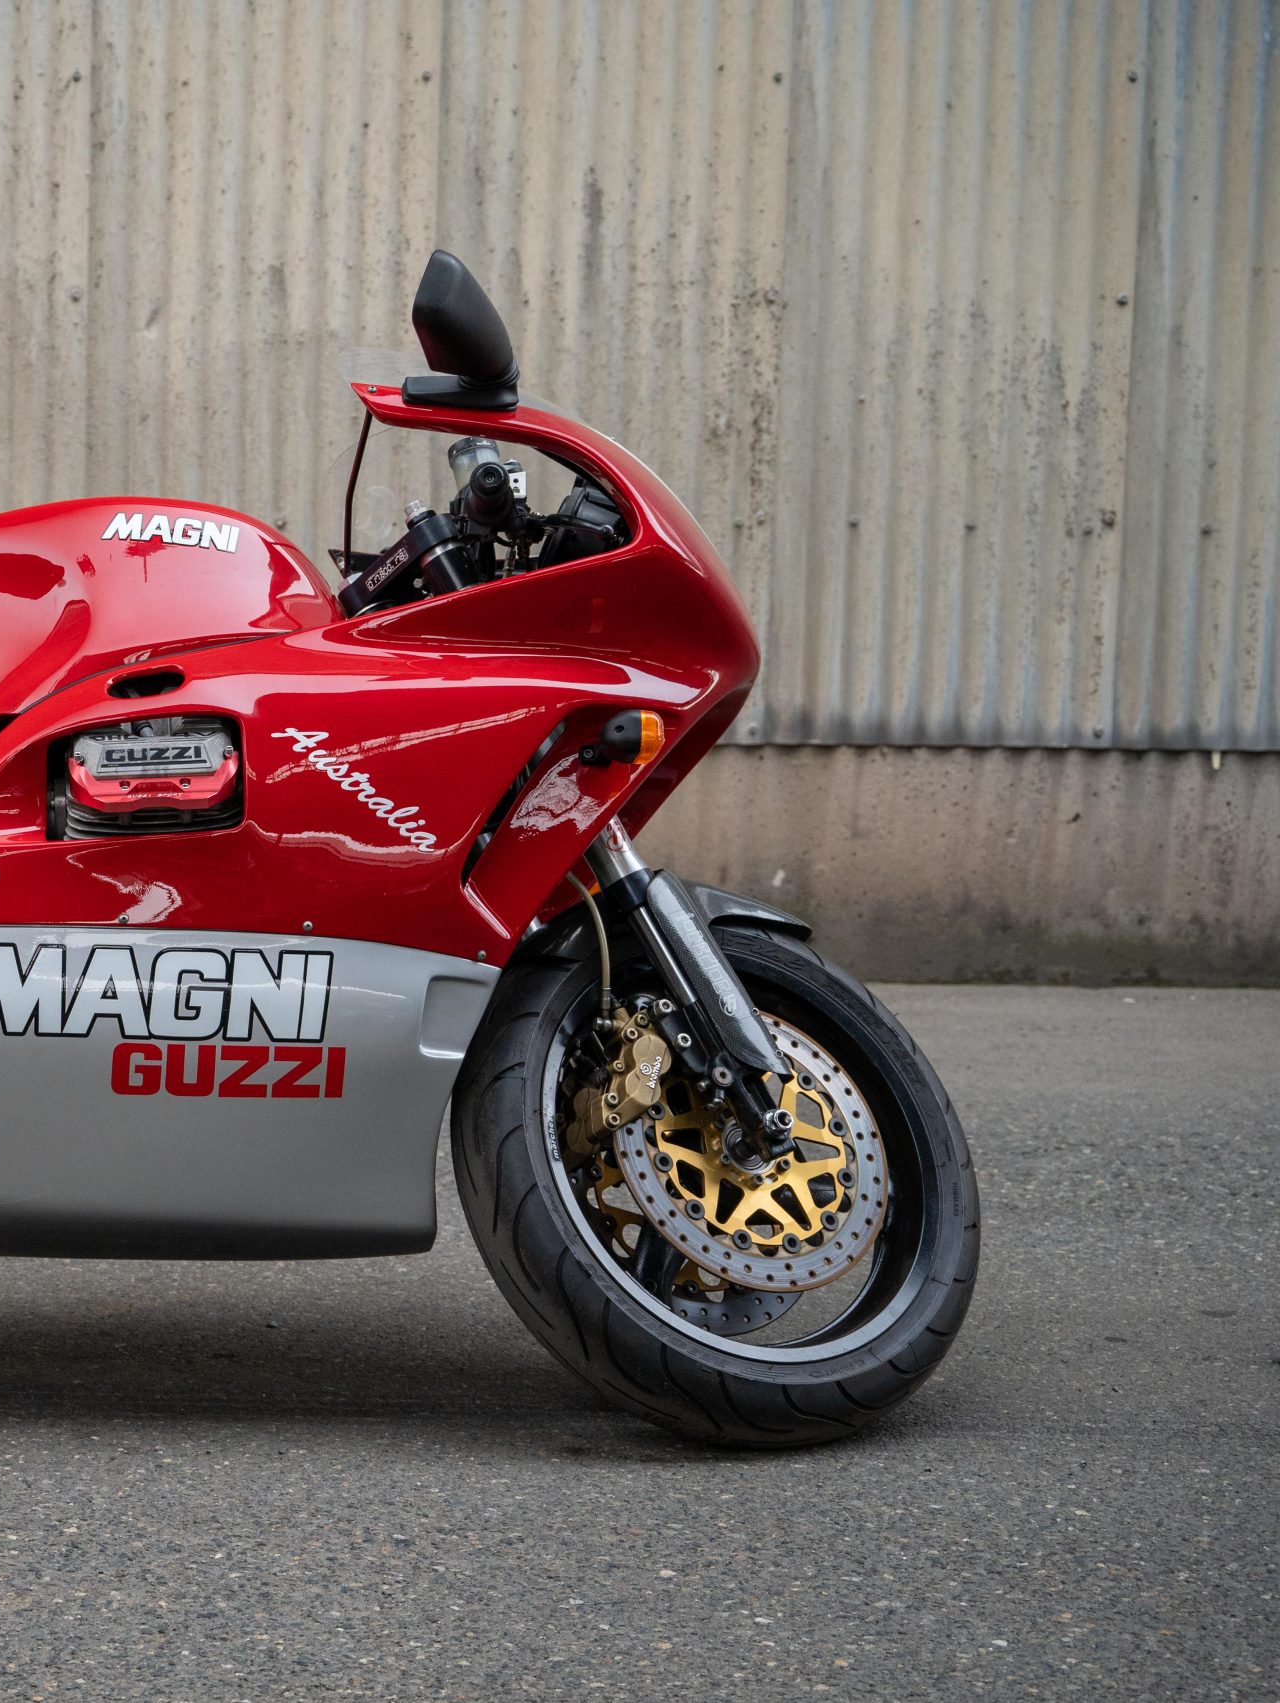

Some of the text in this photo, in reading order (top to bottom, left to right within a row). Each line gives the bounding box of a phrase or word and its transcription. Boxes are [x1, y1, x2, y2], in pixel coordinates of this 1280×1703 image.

[101, 512, 240, 554] MAGNI
[105, 746, 202, 762] GUZZI
[270, 727, 437, 852] Australia
[111, 1042, 346, 1099] GUZZI
[646, 1056, 662, 1089] brembo
